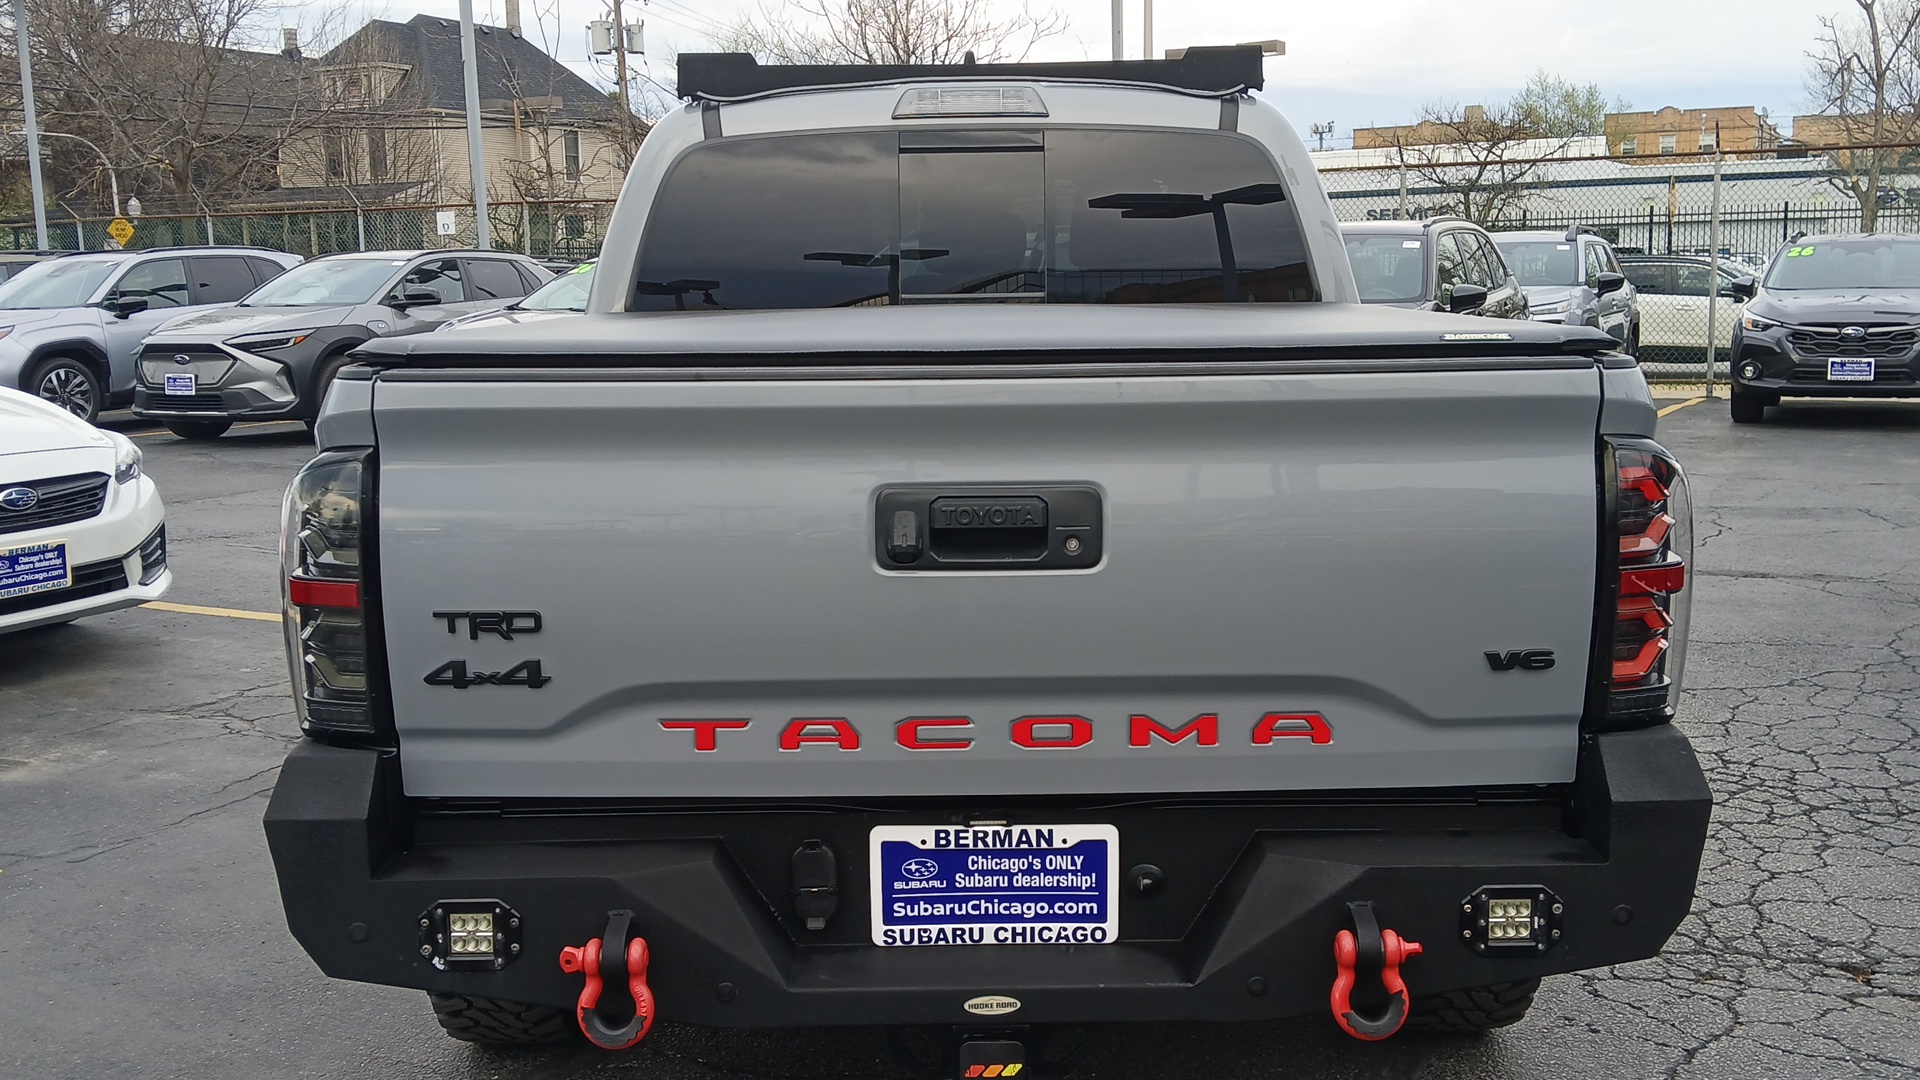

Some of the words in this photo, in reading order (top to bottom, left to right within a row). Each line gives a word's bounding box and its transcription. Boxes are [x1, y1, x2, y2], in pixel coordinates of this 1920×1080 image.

[1787, 246, 1815, 257] 26
[941, 506, 1039, 526] TOYOTA
[8, 543, 49, 555] BERMAN
[0, 569, 63, 585] ubaruChicago.com
[0, 587, 29, 597] UBARU
[31, 580, 68, 591] CHICAGO
[432, 610, 542, 641] TRD
[1484, 648, 1556, 671] V6
[423, 658, 552, 689] 4x4
[658, 709, 1334, 752] TACOMA
[934, 829, 1054, 848] BERMAN
[967, 855, 1041, 872] Chicago's
[1045, 855, 1084, 870] ONLY
[893, 880, 947, 889] SUBARU
[955, 873, 1008, 887] Subaru
[1013, 873, 1096, 890] dealership!
[893, 899, 1098, 918] SubaruChicago.com
[882, 927, 984, 945] SUBARU
[993, 926, 1107, 944] CHICAGO
[968, 1002, 995, 1010] HOOKE
[996, 1001, 1018, 1009] ROAD
